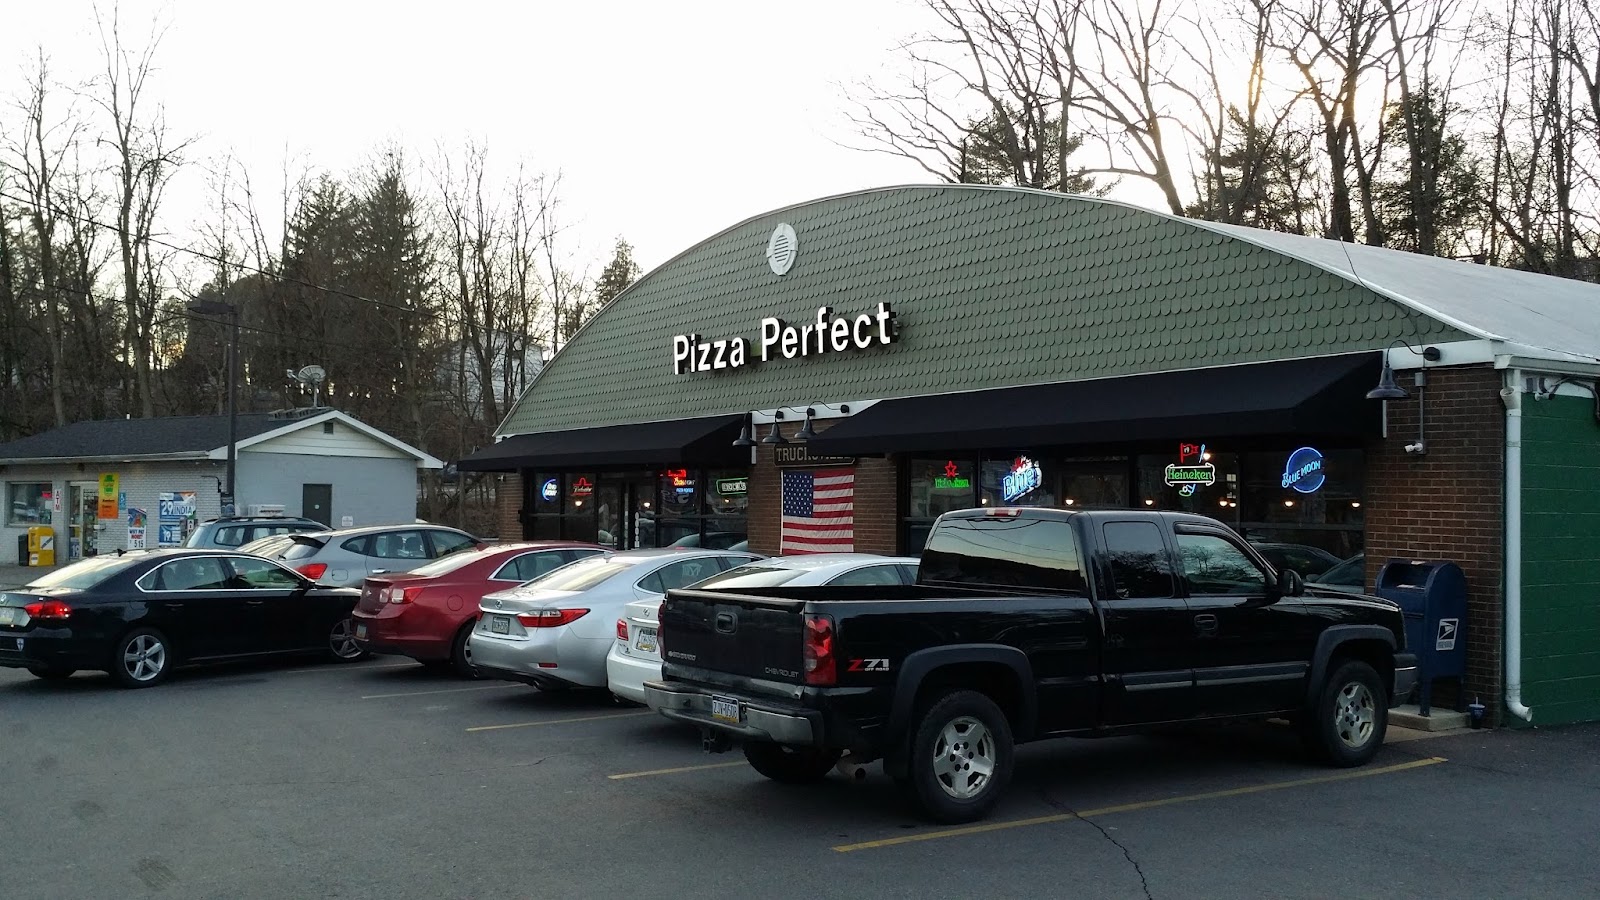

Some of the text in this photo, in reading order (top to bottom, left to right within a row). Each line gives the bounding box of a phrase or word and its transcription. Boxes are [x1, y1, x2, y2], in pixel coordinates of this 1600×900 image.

[673, 302, 891, 375] Pizza Perfect
[1167, 468, 1213, 480] Heineken
[1281, 460, 1321, 489] BLUE MOON
[161, 501, 174, 516] 29
[848, 658, 890, 672] Z71
[765, 667, 800, 679] CHEVROLET
